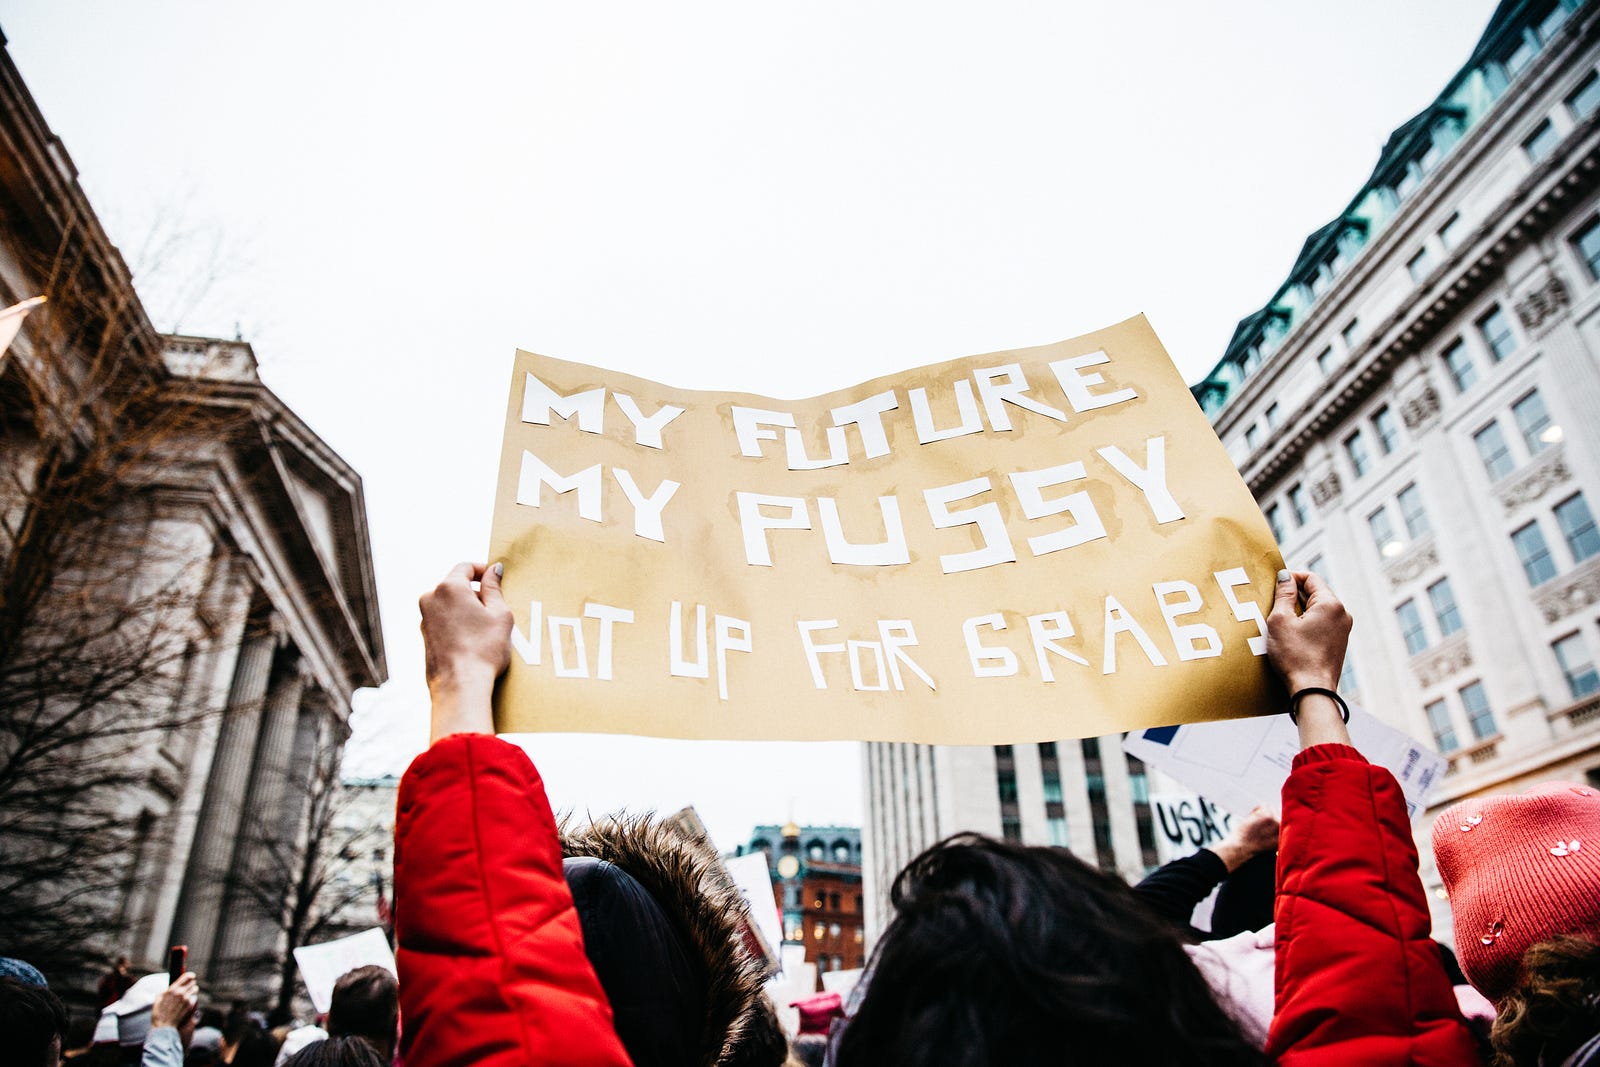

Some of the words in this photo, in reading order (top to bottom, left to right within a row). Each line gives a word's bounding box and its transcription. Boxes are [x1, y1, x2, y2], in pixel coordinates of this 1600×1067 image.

[521, 371, 687, 450] MY
[731, 350, 1138, 471] FUTURE
[516, 449, 681, 543] MY
[736, 436, 1186, 574] PUSSY
[669, 601, 753, 701] UP
[797, 619, 937, 691] FOR
[962, 567, 1267, 683] GRABS
